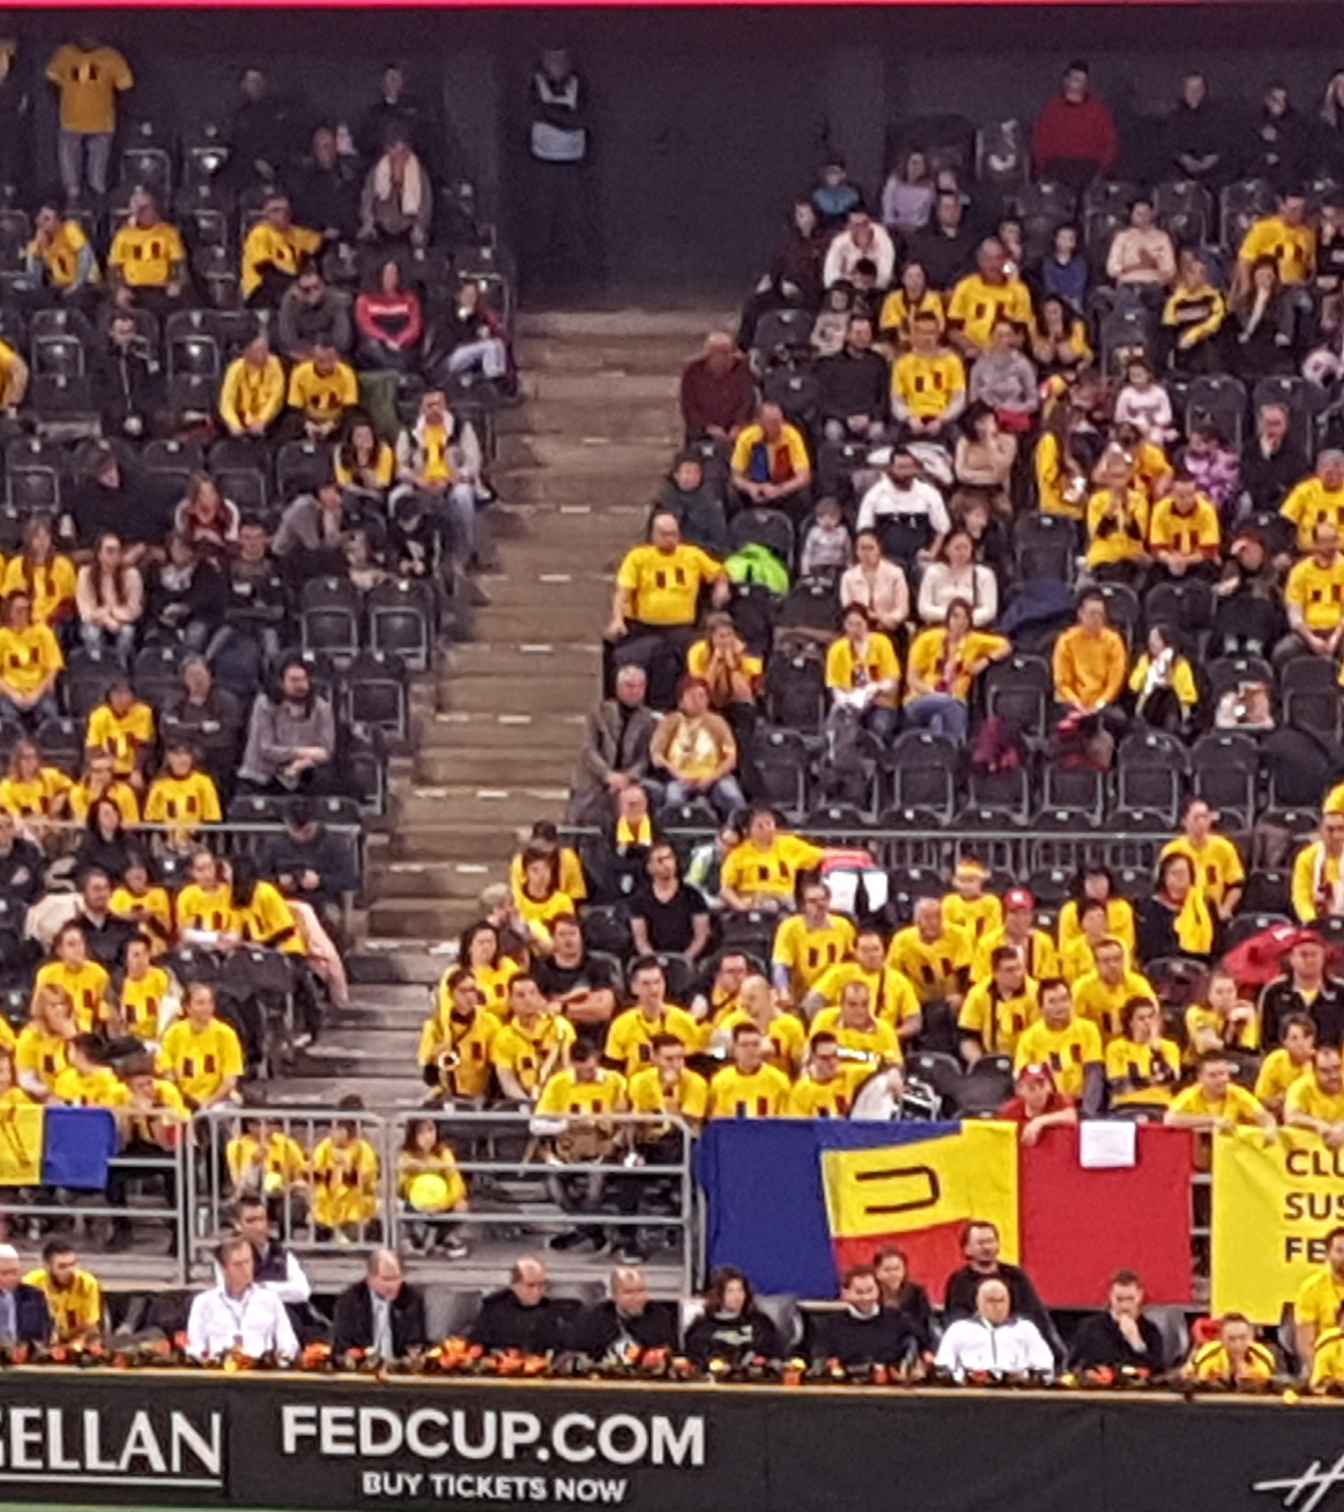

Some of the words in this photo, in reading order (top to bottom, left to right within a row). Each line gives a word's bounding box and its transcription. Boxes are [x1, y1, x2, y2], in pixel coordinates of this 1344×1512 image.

[1285, 1236, 1336, 1264] FE
[281, 1405, 706, 1466] FEDCUP.COM
[362, 1471, 423, 1496] BUY
[429, 1473, 548, 1500] TICKETS
[555, 1478, 627, 1502] NOW
